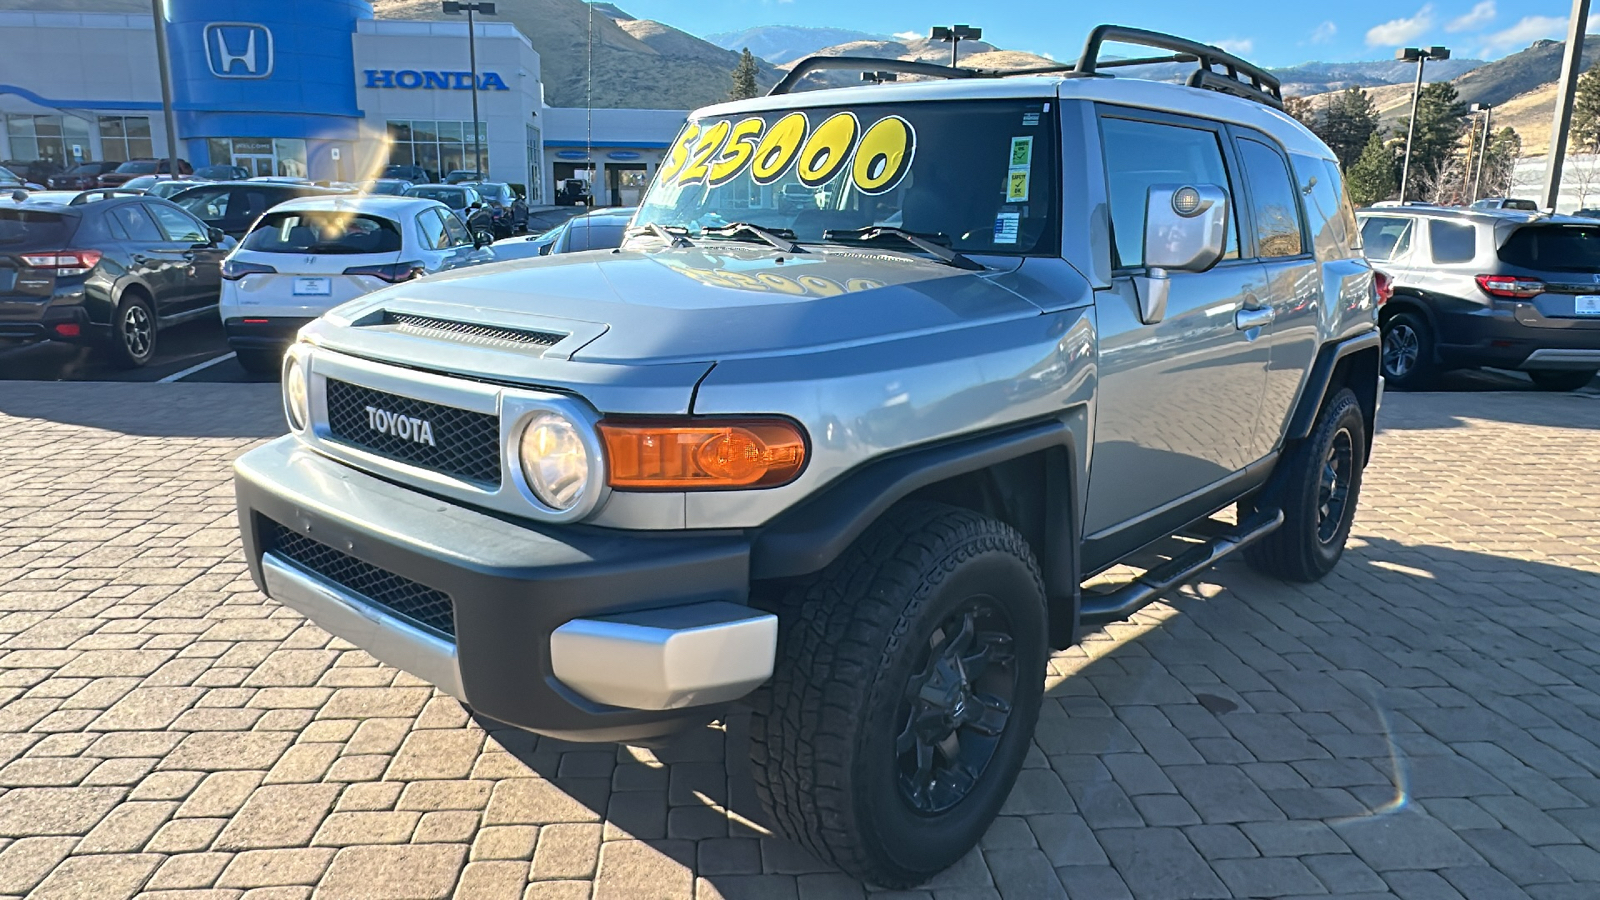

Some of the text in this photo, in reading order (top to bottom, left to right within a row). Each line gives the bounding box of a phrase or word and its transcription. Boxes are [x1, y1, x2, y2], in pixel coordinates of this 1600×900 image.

[363, 70, 510, 91] HONDA
[660, 112, 917, 196] $25000
[365, 405, 436, 447] TOYOTA
